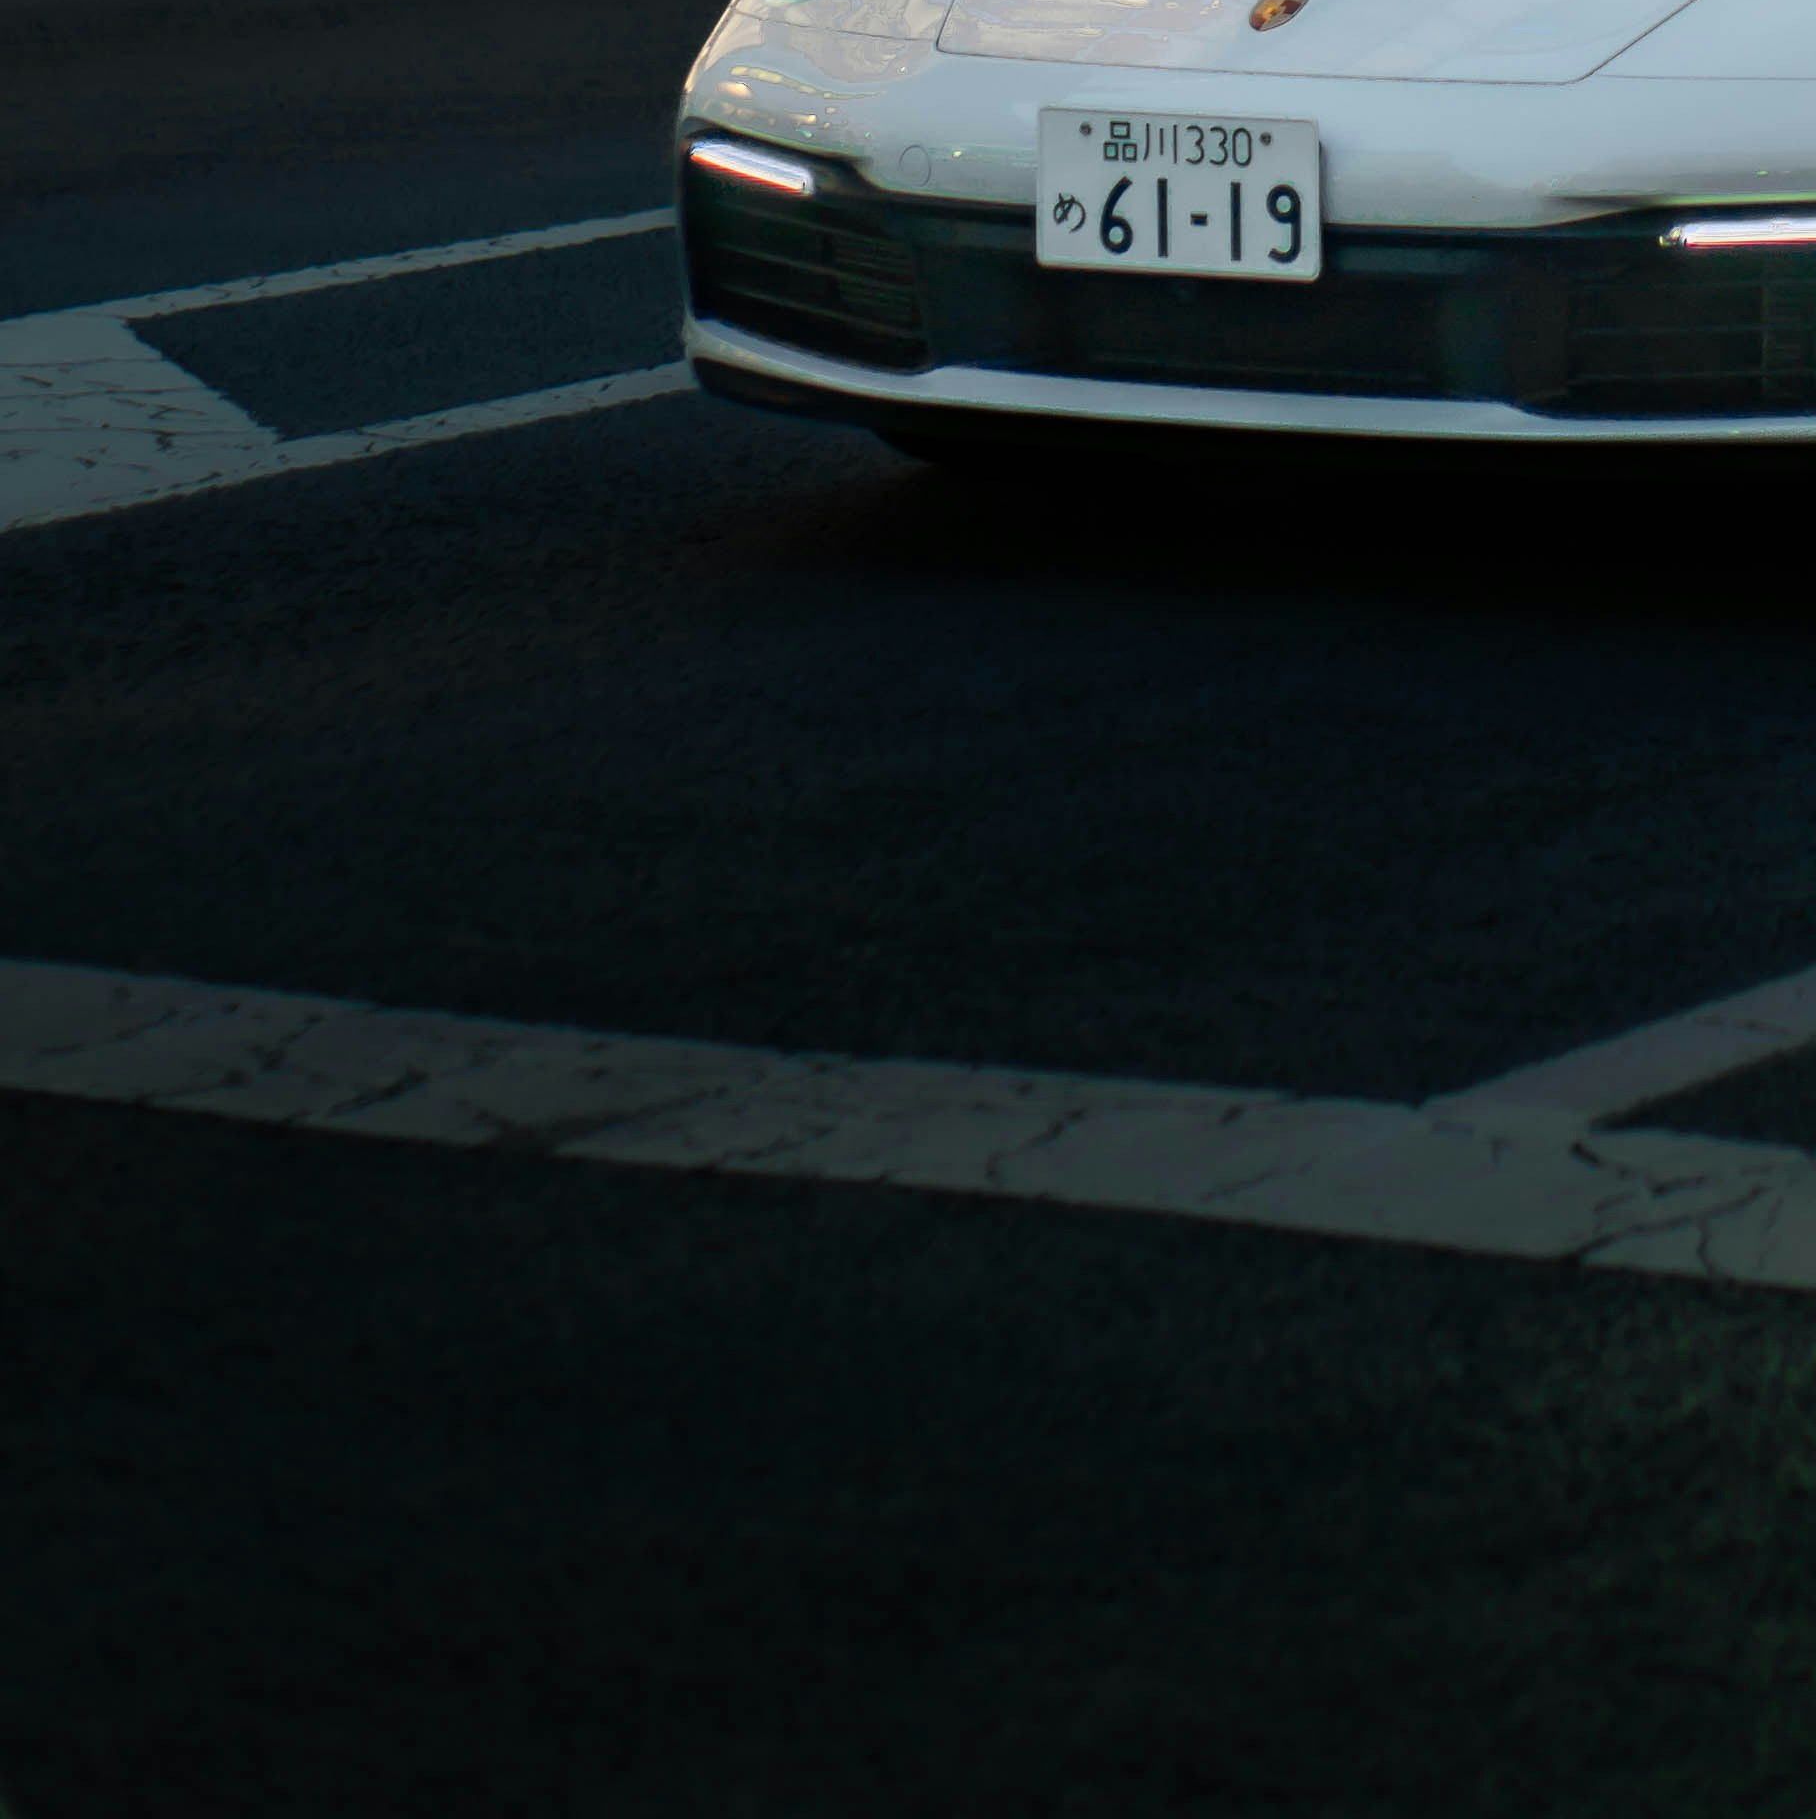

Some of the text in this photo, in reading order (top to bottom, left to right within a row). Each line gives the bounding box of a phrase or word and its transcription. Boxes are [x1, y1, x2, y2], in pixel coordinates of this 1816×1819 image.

[1103, 120, 1254, 167] 品川330
[1052, 175, 1303, 264] め 61-19
